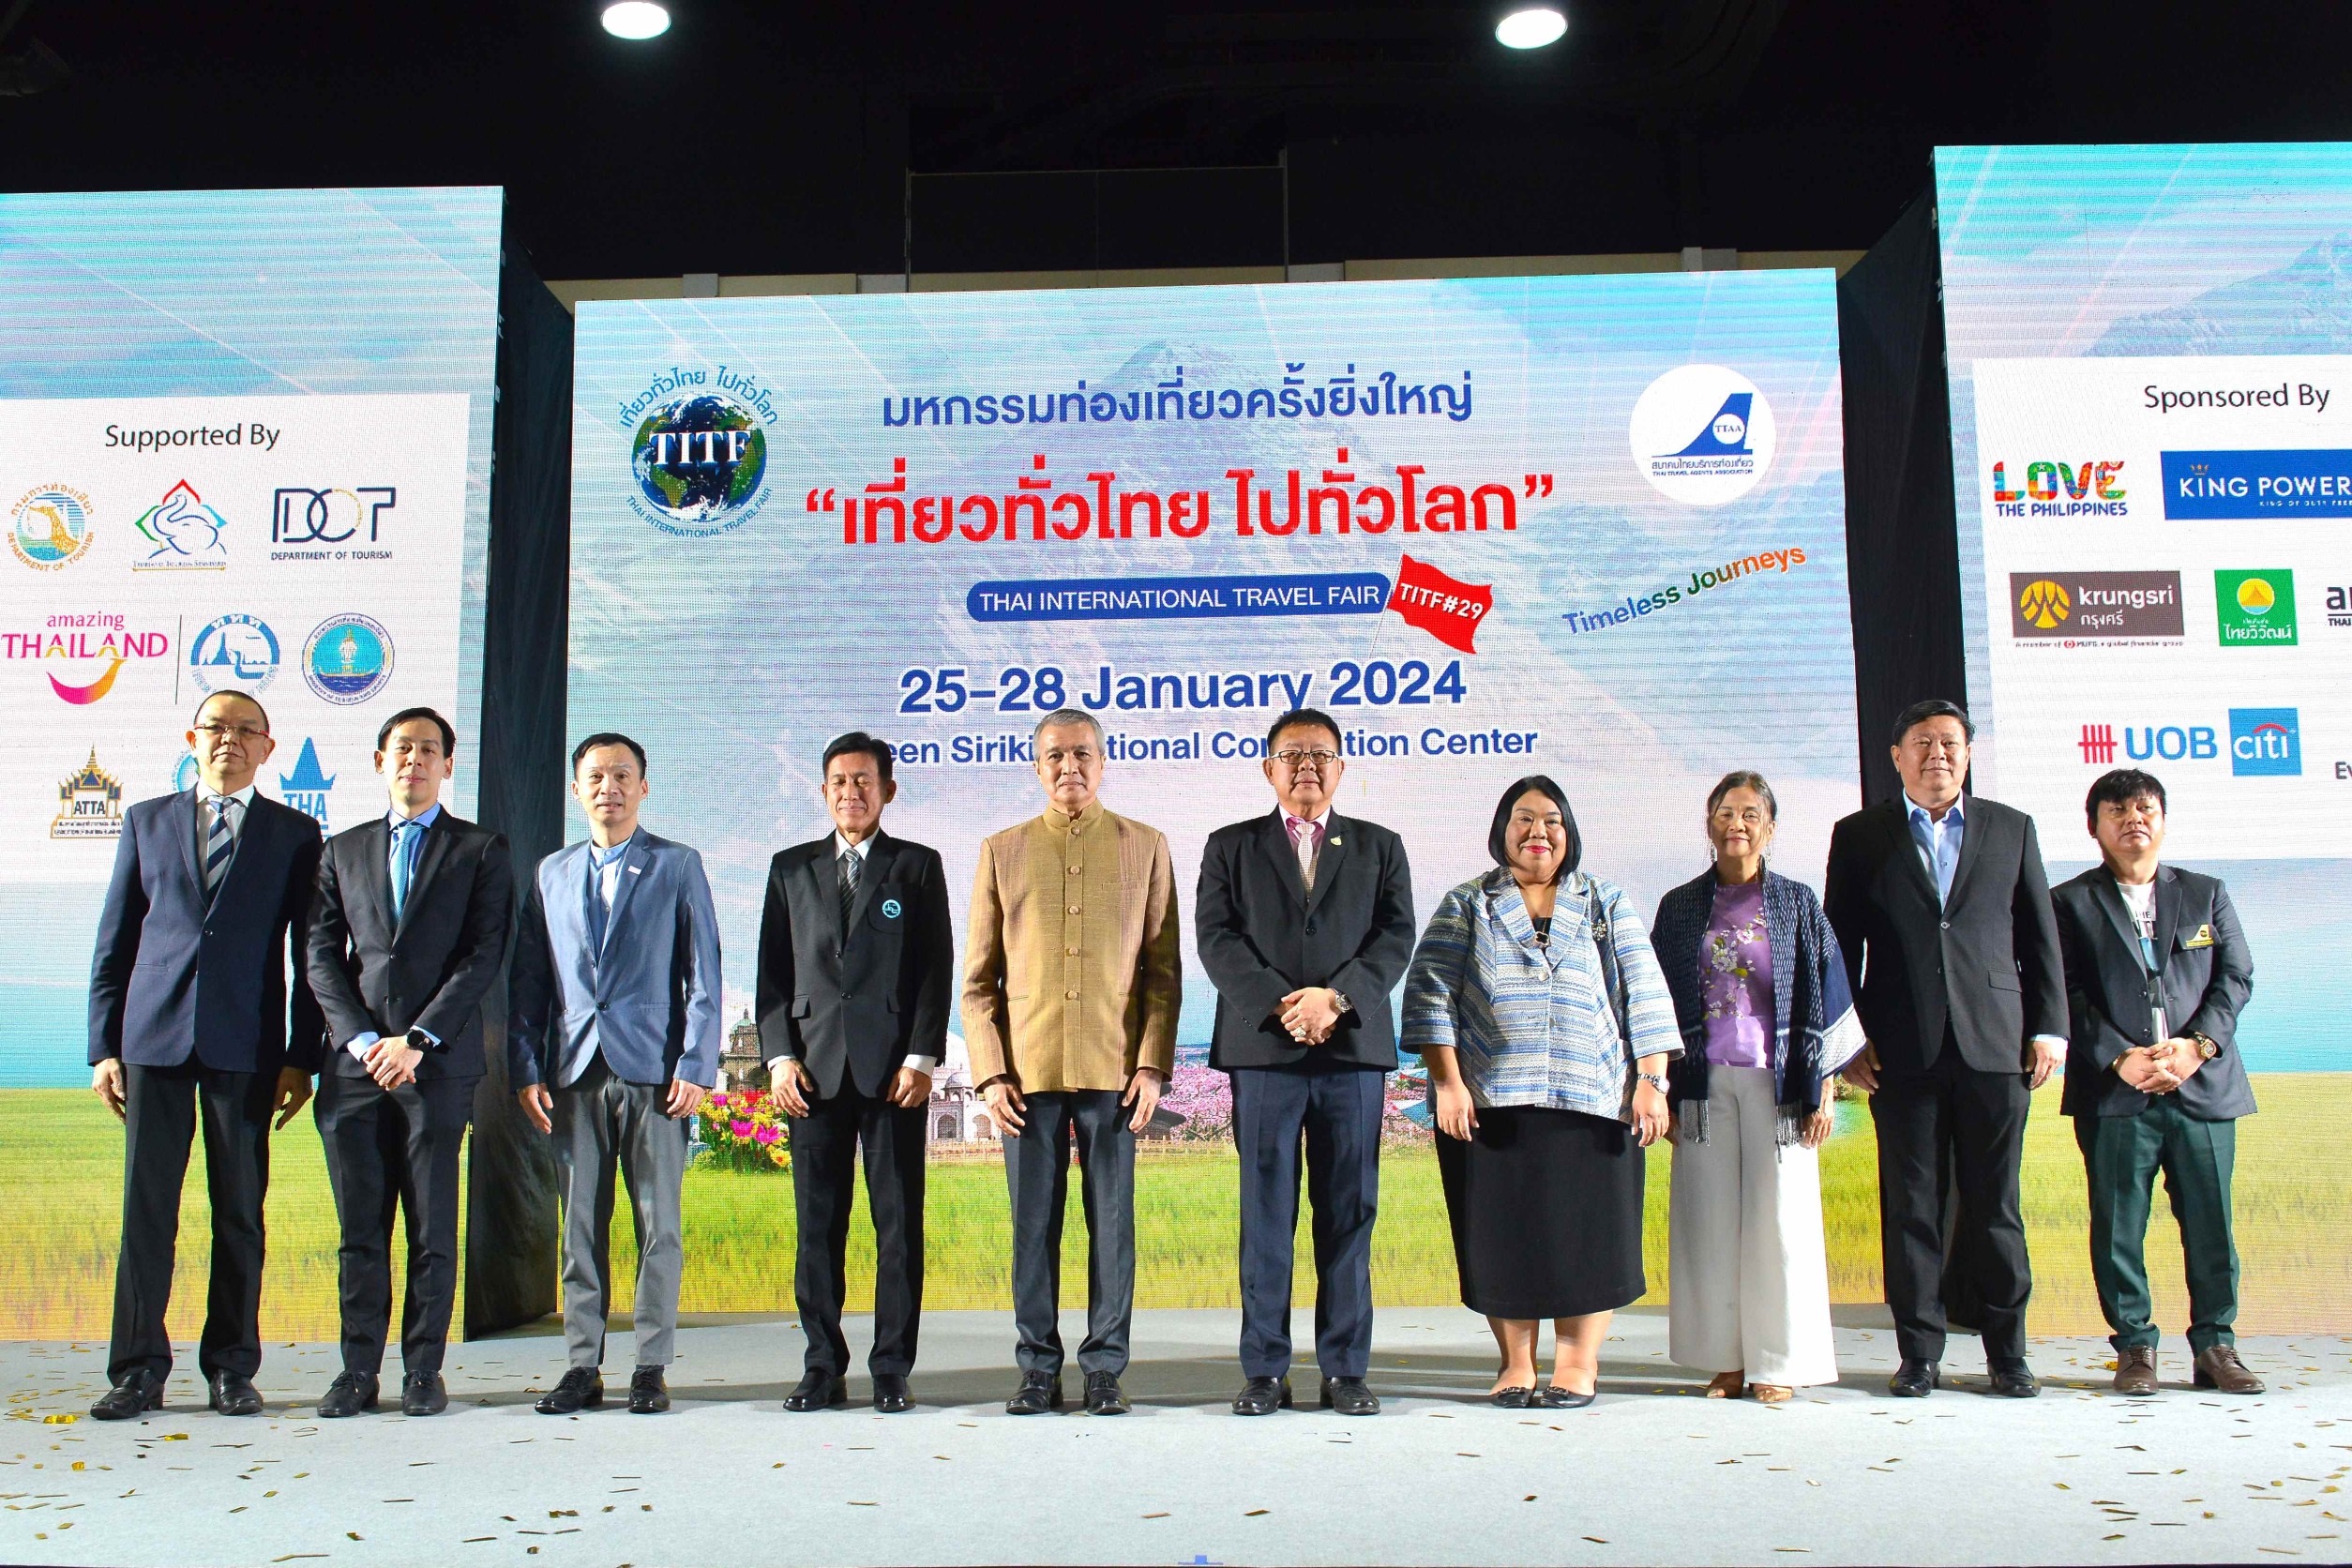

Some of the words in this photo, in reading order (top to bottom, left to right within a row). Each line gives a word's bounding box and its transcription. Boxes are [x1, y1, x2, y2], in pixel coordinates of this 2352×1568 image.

[619, 367, 706, 428] เที่ยวทั่วไทย
[716, 365, 777, 425] ไปทั่วโลก
[882, 362, 1473, 428] มหกรรมท่องเที่ยวครั้งยิ่งใหญ่
[2144, 383, 2289, 413] Sponsored
[2299, 384, 2330, 413] By
[105, 423, 242, 452] Supported
[250, 424, 280, 451] By
[648, 430, 751, 464] TITF
[1993, 460, 2127, 502] LOVE
[2179, 477, 2249, 497] KING
[2258, 476, 2352, 496] POWER
[272, 487, 397, 543] DOT
[626, 494, 645, 519] THAI
[645, 513, 722, 537] INTERNATIONAL
[723, 509, 757, 532] TRAVEL
[755, 487, 773, 512] FAIR
[1996, 503, 2026, 517] THE
[2031, 502, 2128, 517] PHILIPPINES
[270, 551, 332, 561] DEPARTMENT
[335, 551, 347, 561] OF
[351, 550, 393, 560] TOURISM
[979, 592, 1033, 611] THAI
[1039, 588, 1228, 611] INTERNATIONAL
[1231, 587, 1322, 608] TRAVEL
[1328, 585, 1380, 605] FAIR
[1399, 581, 1485, 621] TITF#29
[1561, 586, 1681, 635] Timeless
[1687, 547, 1806, 596] Journeys
[2078, 584, 2174, 610] krungsri
[47, 611, 125, 631] amazing
[2081, 610, 2124, 629] กรุงศรี
[2223, 624, 2292, 640] ไทยวิวัฒน์
[1, 632, 169, 658] THAILAND
[1081, 664, 1313, 716] January
[1329, 659, 1467, 707] 2024
[951, 735, 1034, 763] Siriki
[1106, 732, 1200, 761] tional
[1421, 728, 1538, 756] Center
[2124, 727, 2219, 761] UOB
[2233, 729, 2289, 761] citi
[73, 800, 106, 815] ATTA
[283, 793, 328, 822] THA
